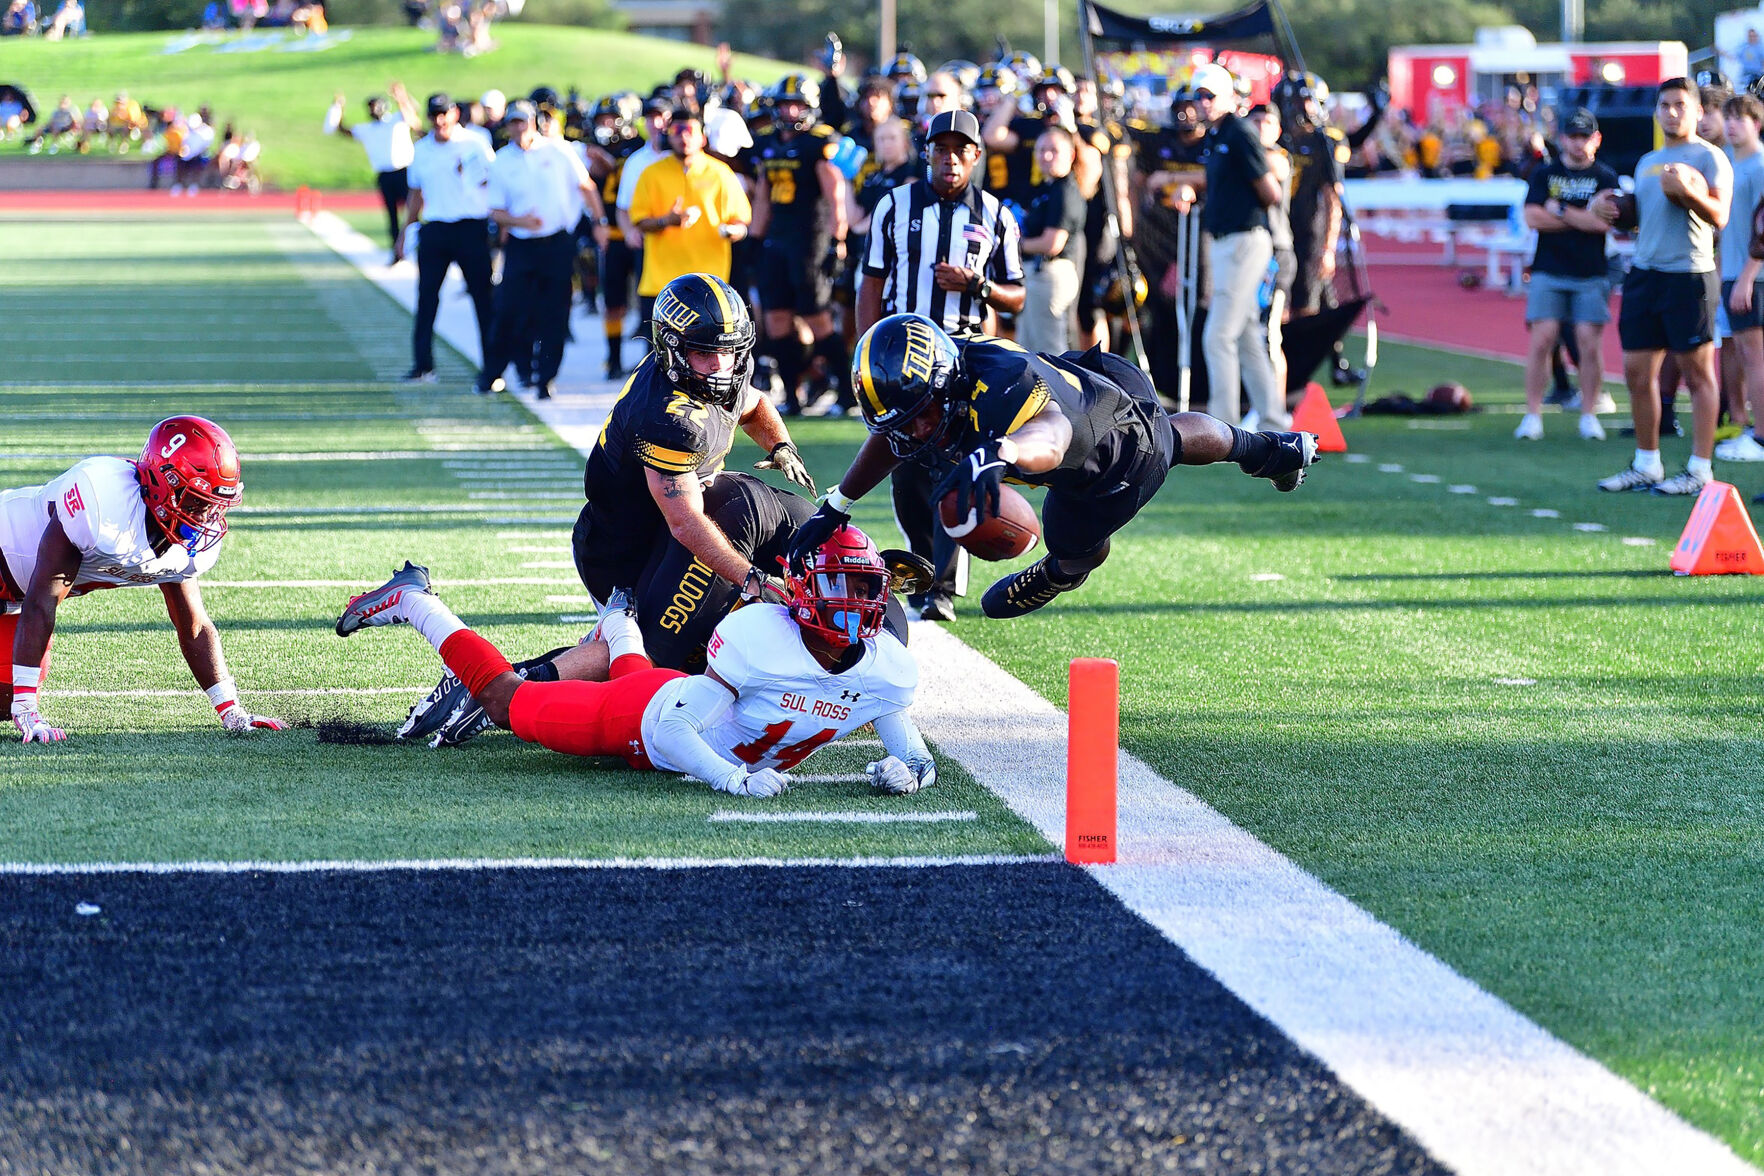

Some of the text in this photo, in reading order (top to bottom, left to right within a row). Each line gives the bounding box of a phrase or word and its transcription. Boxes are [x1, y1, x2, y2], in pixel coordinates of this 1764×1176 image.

[910, 218, 922, 233] S
[161, 433, 187, 459] 9
[66, 487, 81, 514] SR
[843, 555, 871, 565] Riddell
[780, 692, 852, 721] SUL ROSS
[730, 719, 839, 773] 14
